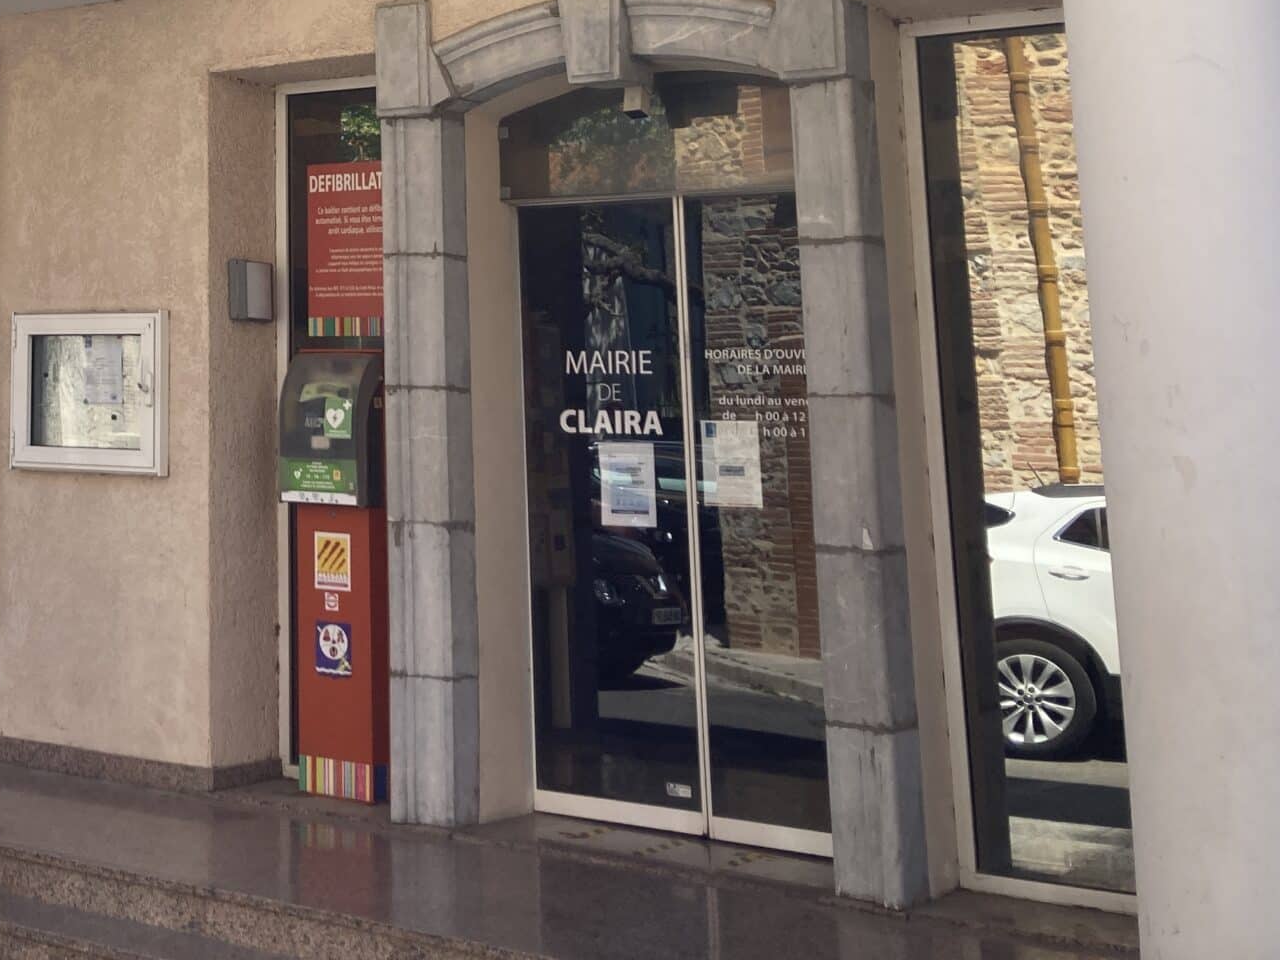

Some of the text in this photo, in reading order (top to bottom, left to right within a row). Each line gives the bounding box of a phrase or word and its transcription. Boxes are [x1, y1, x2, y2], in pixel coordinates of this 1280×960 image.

[308, 171, 382, 193] DEFIBRILLAT
[704, 348, 761, 360] HORAIRES
[565, 349, 653, 375] MAIRIE
[737, 364, 753, 375] DE
[755, 364, 771, 375] LA
[599, 382, 623, 402] DE
[719, 394, 734, 406] du
[735, 394, 766, 406] lundi
[767, 397, 782, 406] au
[559, 408, 664, 436] CLAIRA
[722, 409, 737, 421] de
[765, 411, 780, 421] 00
[792, 411, 807, 422] 12
[773, 426, 788, 437] 00
